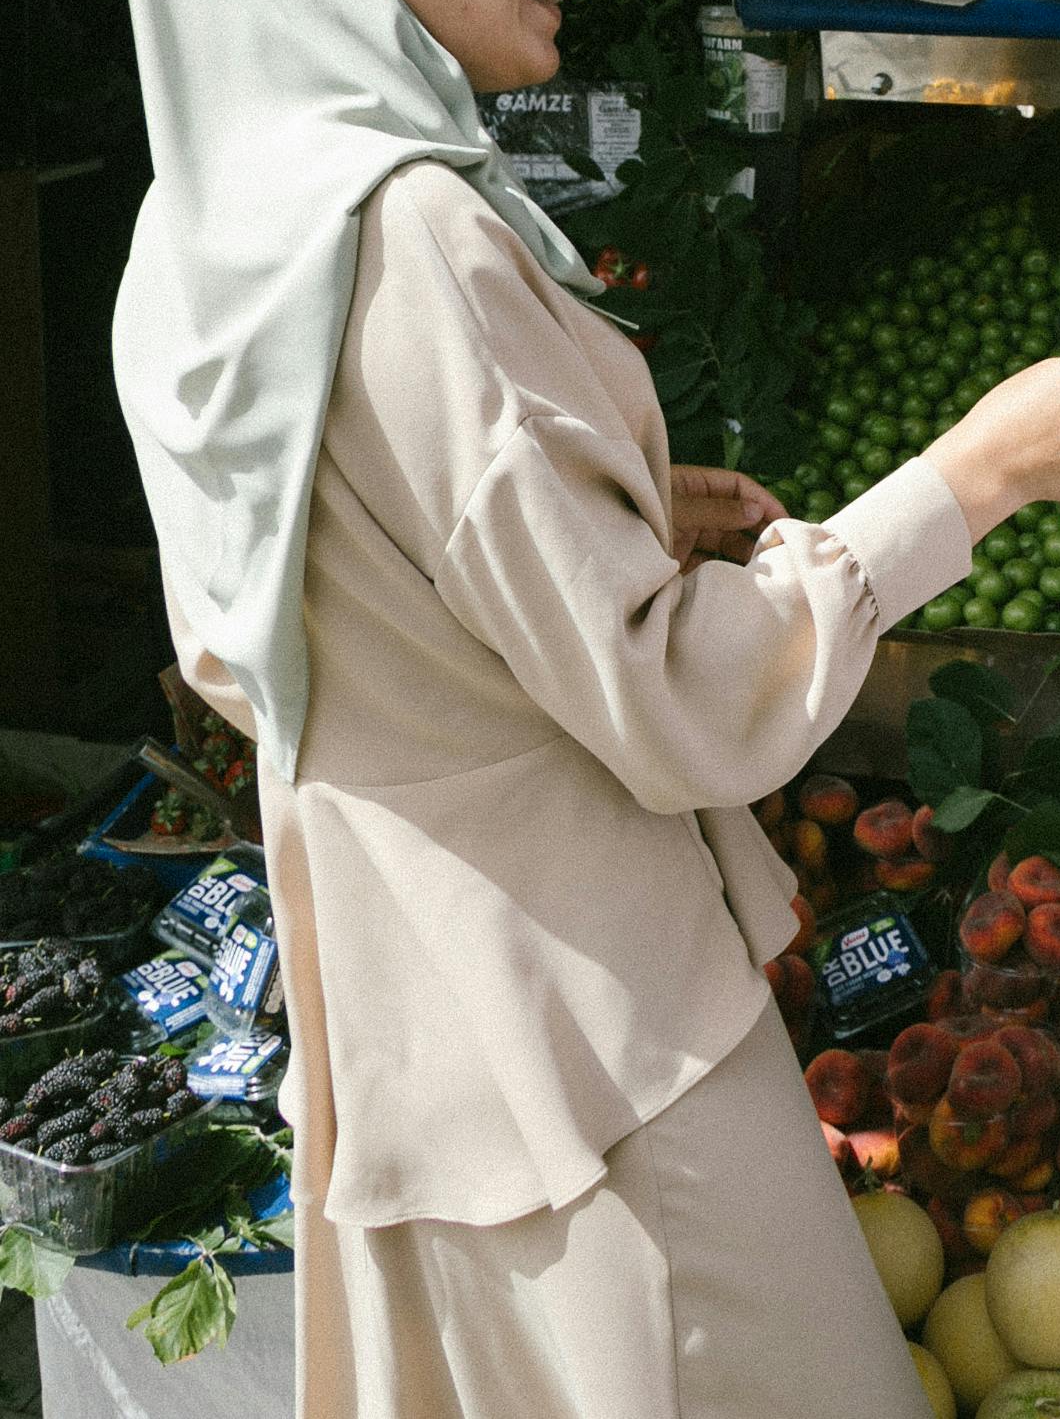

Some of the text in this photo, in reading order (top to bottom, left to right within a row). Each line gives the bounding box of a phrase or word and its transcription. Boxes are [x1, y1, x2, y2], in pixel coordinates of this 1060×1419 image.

[201, 880, 238, 917] BL
[822, 957, 847, 988] DR
[840, 929, 910, 977] BLUE
[145, 964, 200, 1008] BLUE
